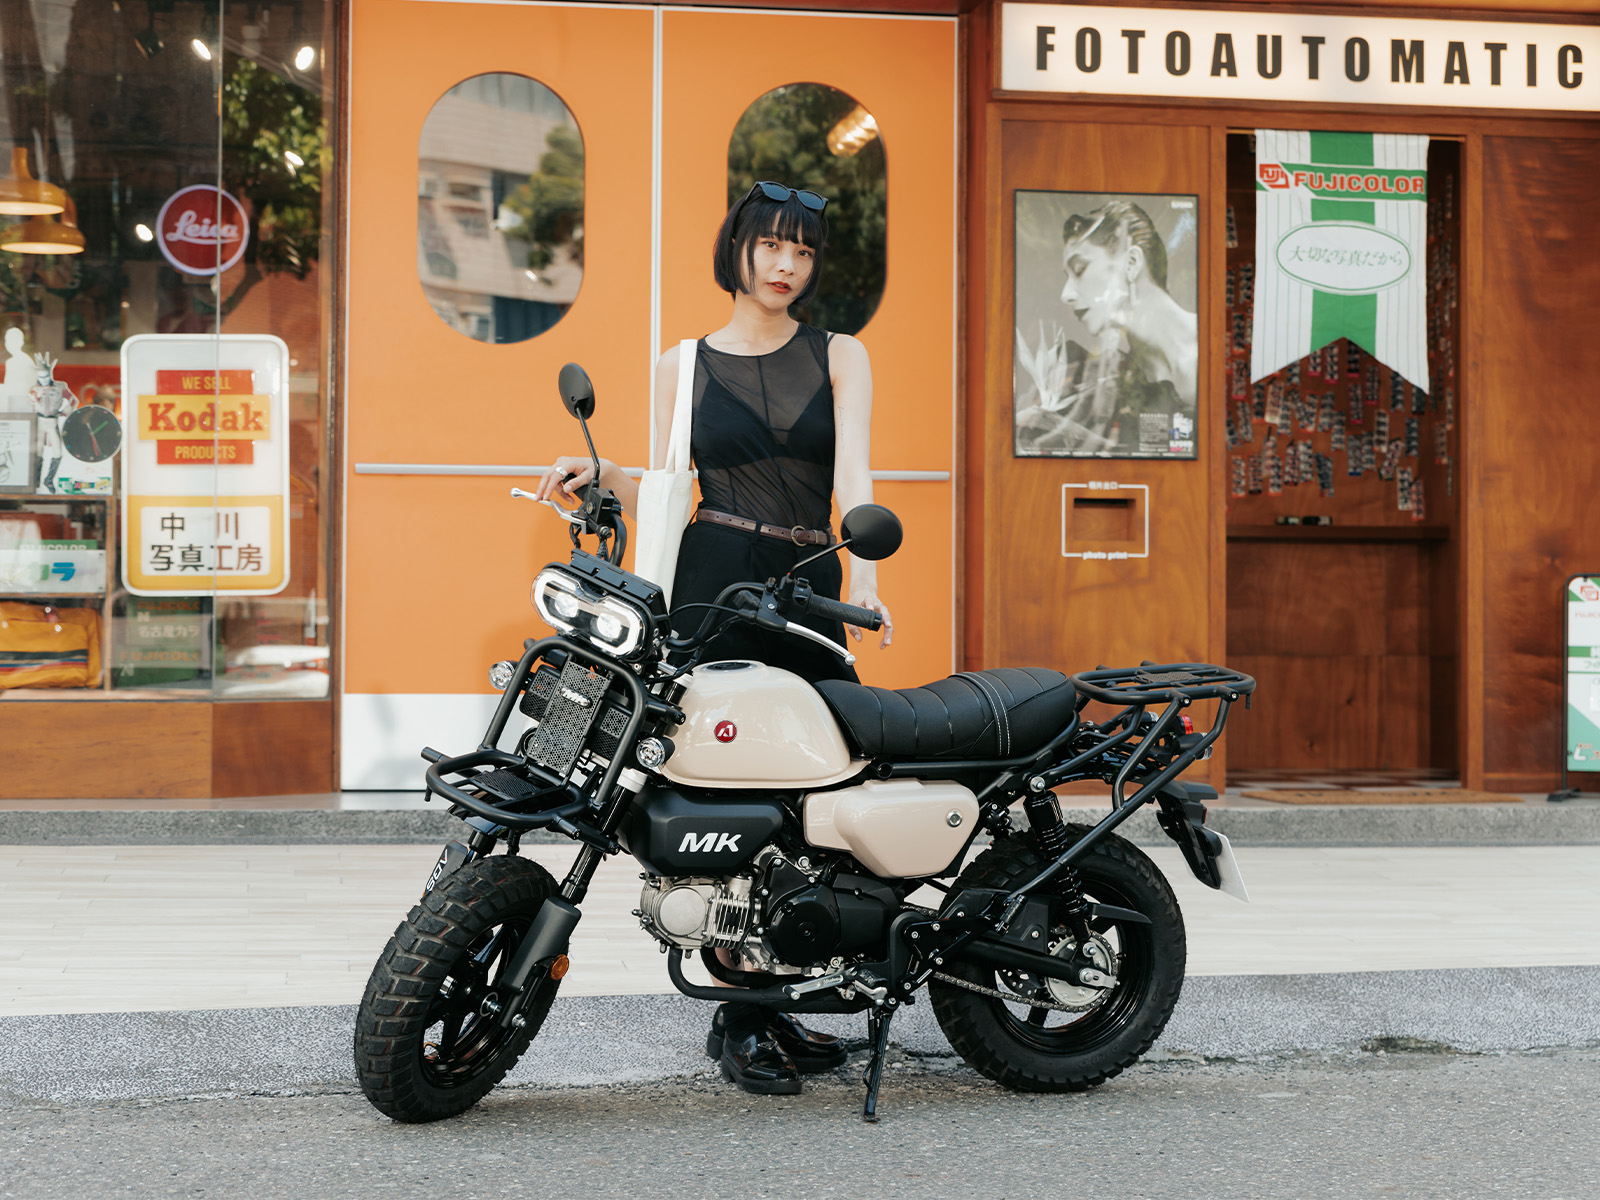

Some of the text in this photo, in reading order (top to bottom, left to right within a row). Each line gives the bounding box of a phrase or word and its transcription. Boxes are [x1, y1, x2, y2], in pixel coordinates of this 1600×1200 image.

[1036, 26, 1583, 89] FOTOAUTOMATIC
[1293, 170, 1425, 195] FUJICOLOR
[165, 210, 241, 245] Leica
[1289, 245, 1403, 267] 大切な写真だから
[181, 376, 232, 390] WE SELL
[148, 402, 264, 432] Kodak
[175, 445, 237, 460] PRODUCTS
[149, 543, 263, 572] 写真工房
[678, 832, 742, 853] MK
